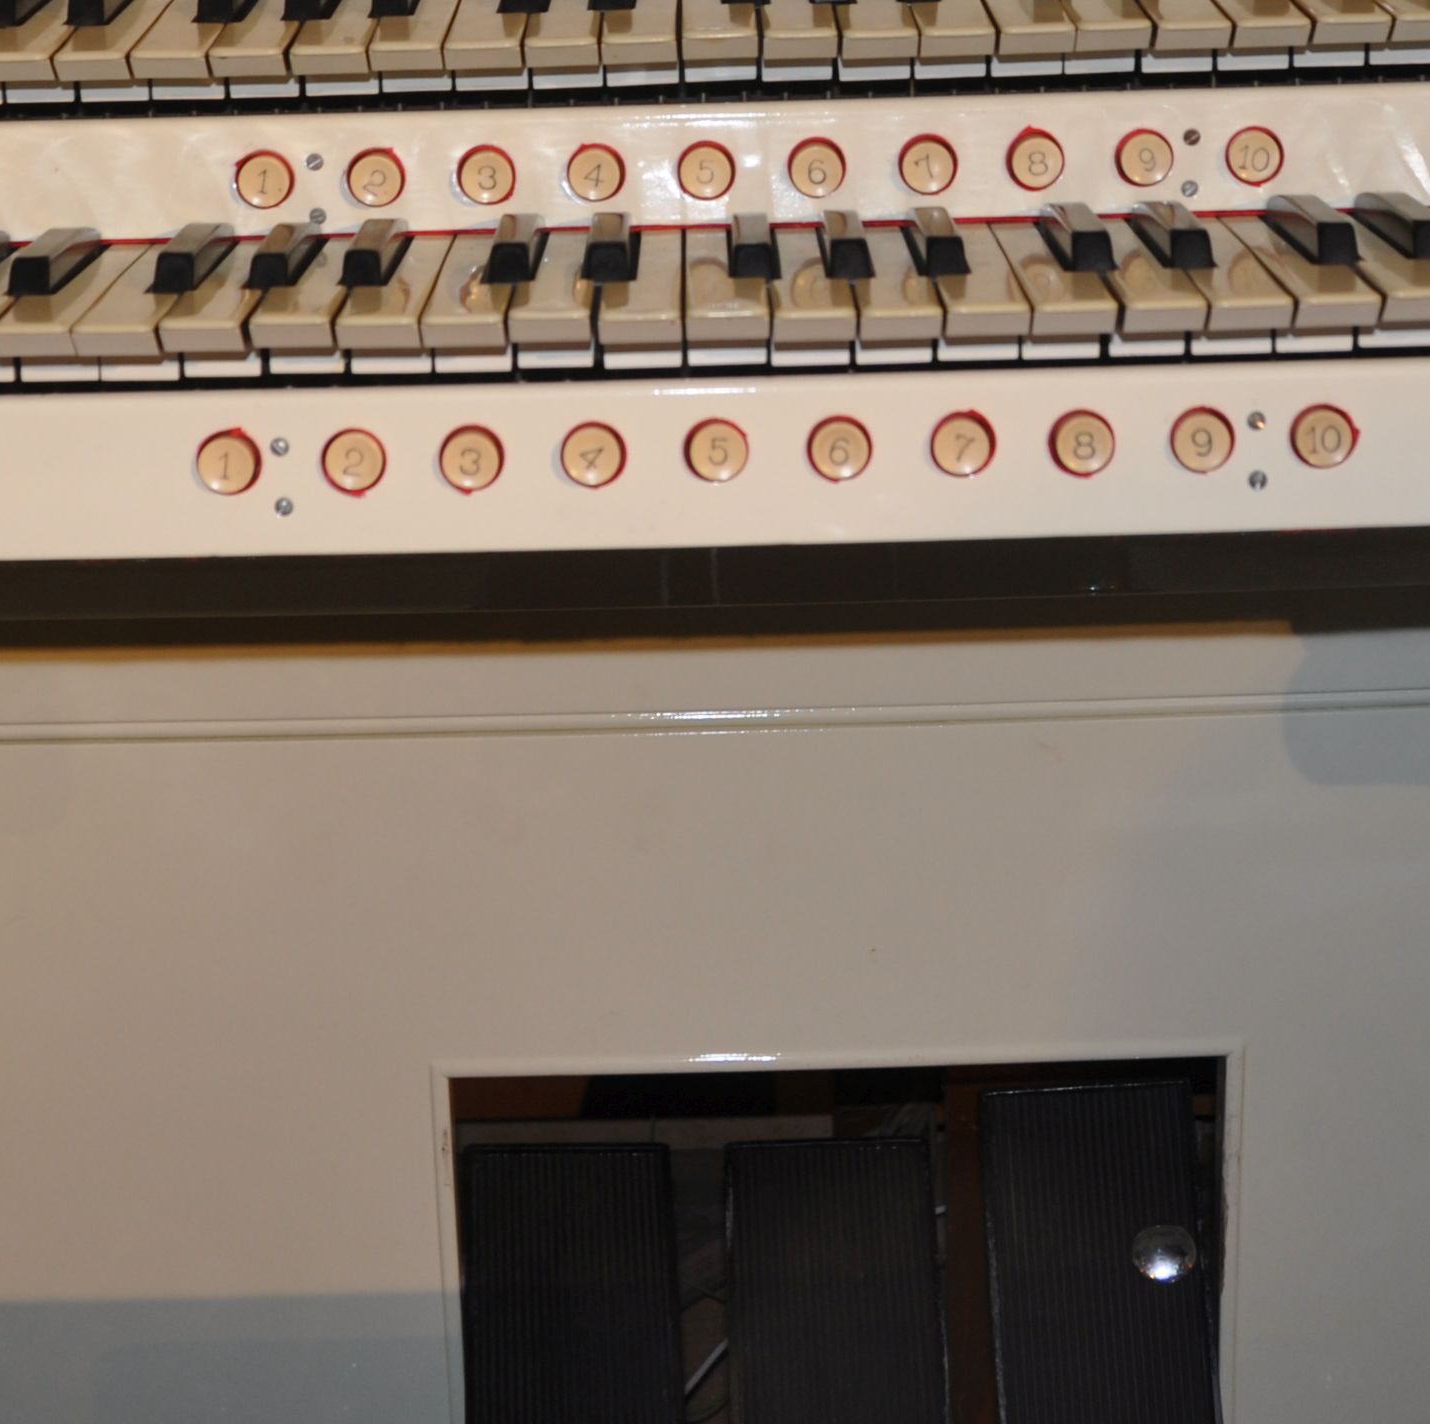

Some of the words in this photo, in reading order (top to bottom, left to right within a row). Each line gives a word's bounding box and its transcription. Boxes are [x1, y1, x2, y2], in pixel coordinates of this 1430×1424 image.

[696, 159, 716, 186] 5
[807, 159, 828, 185] 6
[914, 154, 934, 180] 7
[1027, 149, 1049, 176] 8
[1137, 146, 1157, 171] 9
[1237, 145, 1271, 173] 10
[257, 168, 269, 195] 1
[363, 169, 387, 197] 2
[477, 165, 497, 192] 3
[583, 163, 604, 188] 4
[708, 437, 728, 467] 5
[829, 436, 849, 466] 6
[954, 432, 975, 463] 7
[1073, 430, 1096, 461] 8
[1191, 427, 1213, 457] 9
[1307, 425, 1342, 455] 10
[218, 452, 231, 480] 1
[344, 447, 365, 477] 2
[459, 447, 481, 477] 3
[579, 445, 604, 472] 4
